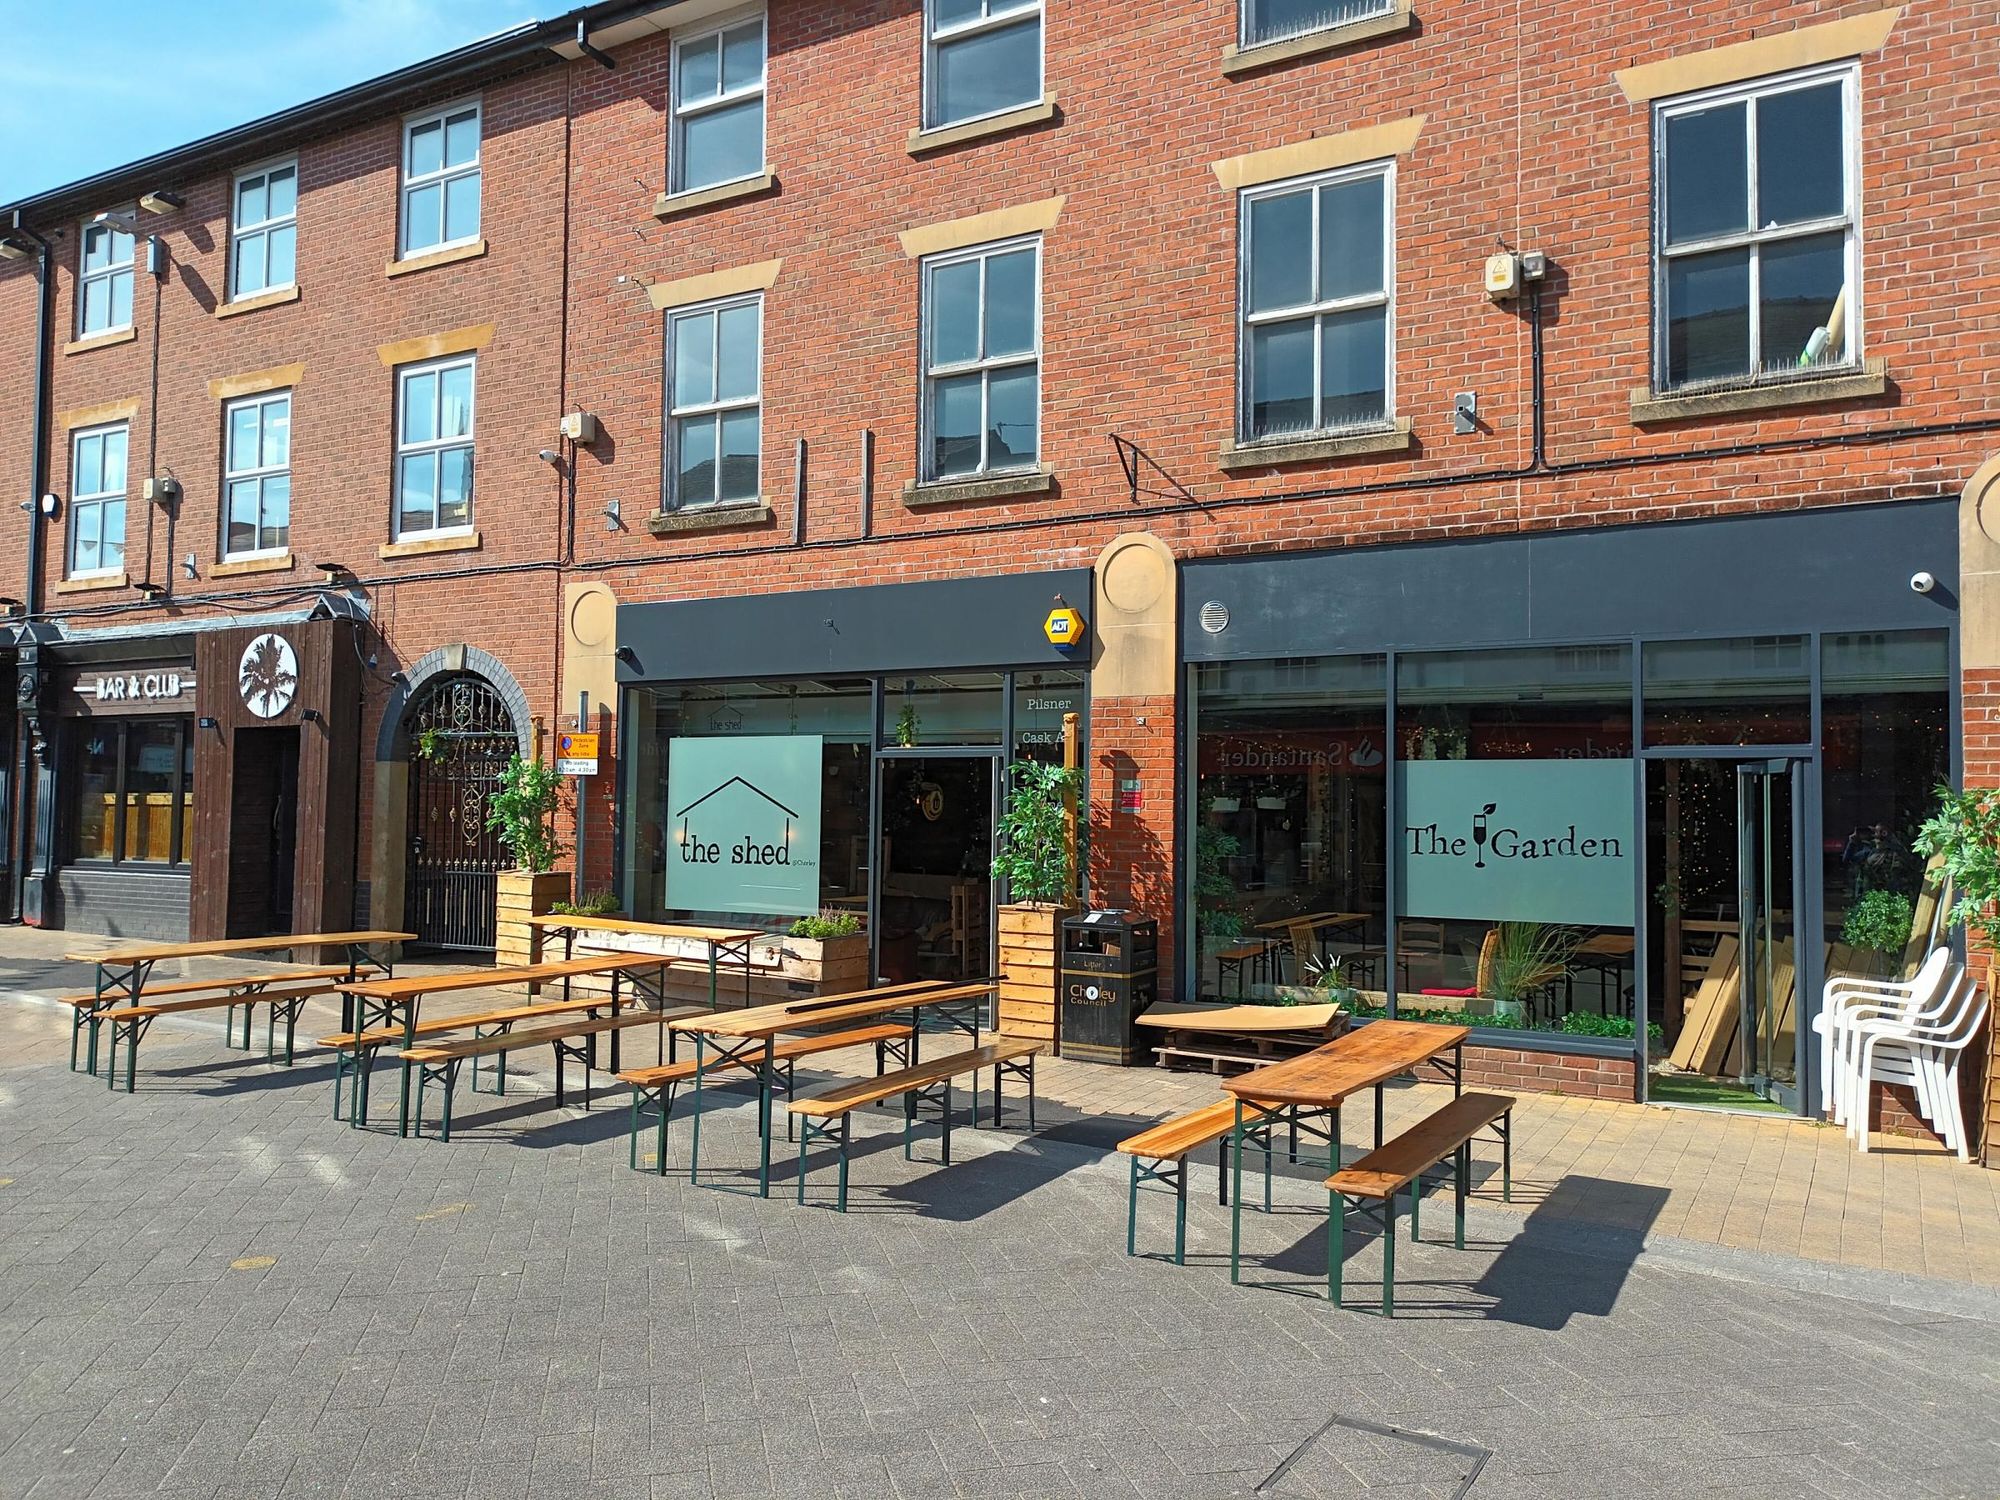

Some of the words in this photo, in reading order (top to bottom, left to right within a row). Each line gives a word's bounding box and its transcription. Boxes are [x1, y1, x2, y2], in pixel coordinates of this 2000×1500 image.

[1051, 621, 1068, 632] ADT
[96, 677, 126, 700] BAR
[127, 677, 140, 698] &
[143, 674, 181, 698] CLUB
[1027, 698, 1072, 710] Pilsner
[710, 718, 723, 731] the
[724, 717, 742, 731] shed
[1022, 732, 1051, 744] Cask
[680, 825, 720, 863] the
[731, 825, 790, 865] shed
[1404, 823, 1467, 855] The
[1491, 826, 1624, 859] Garden
[1070, 997, 1107, 1007] Council
